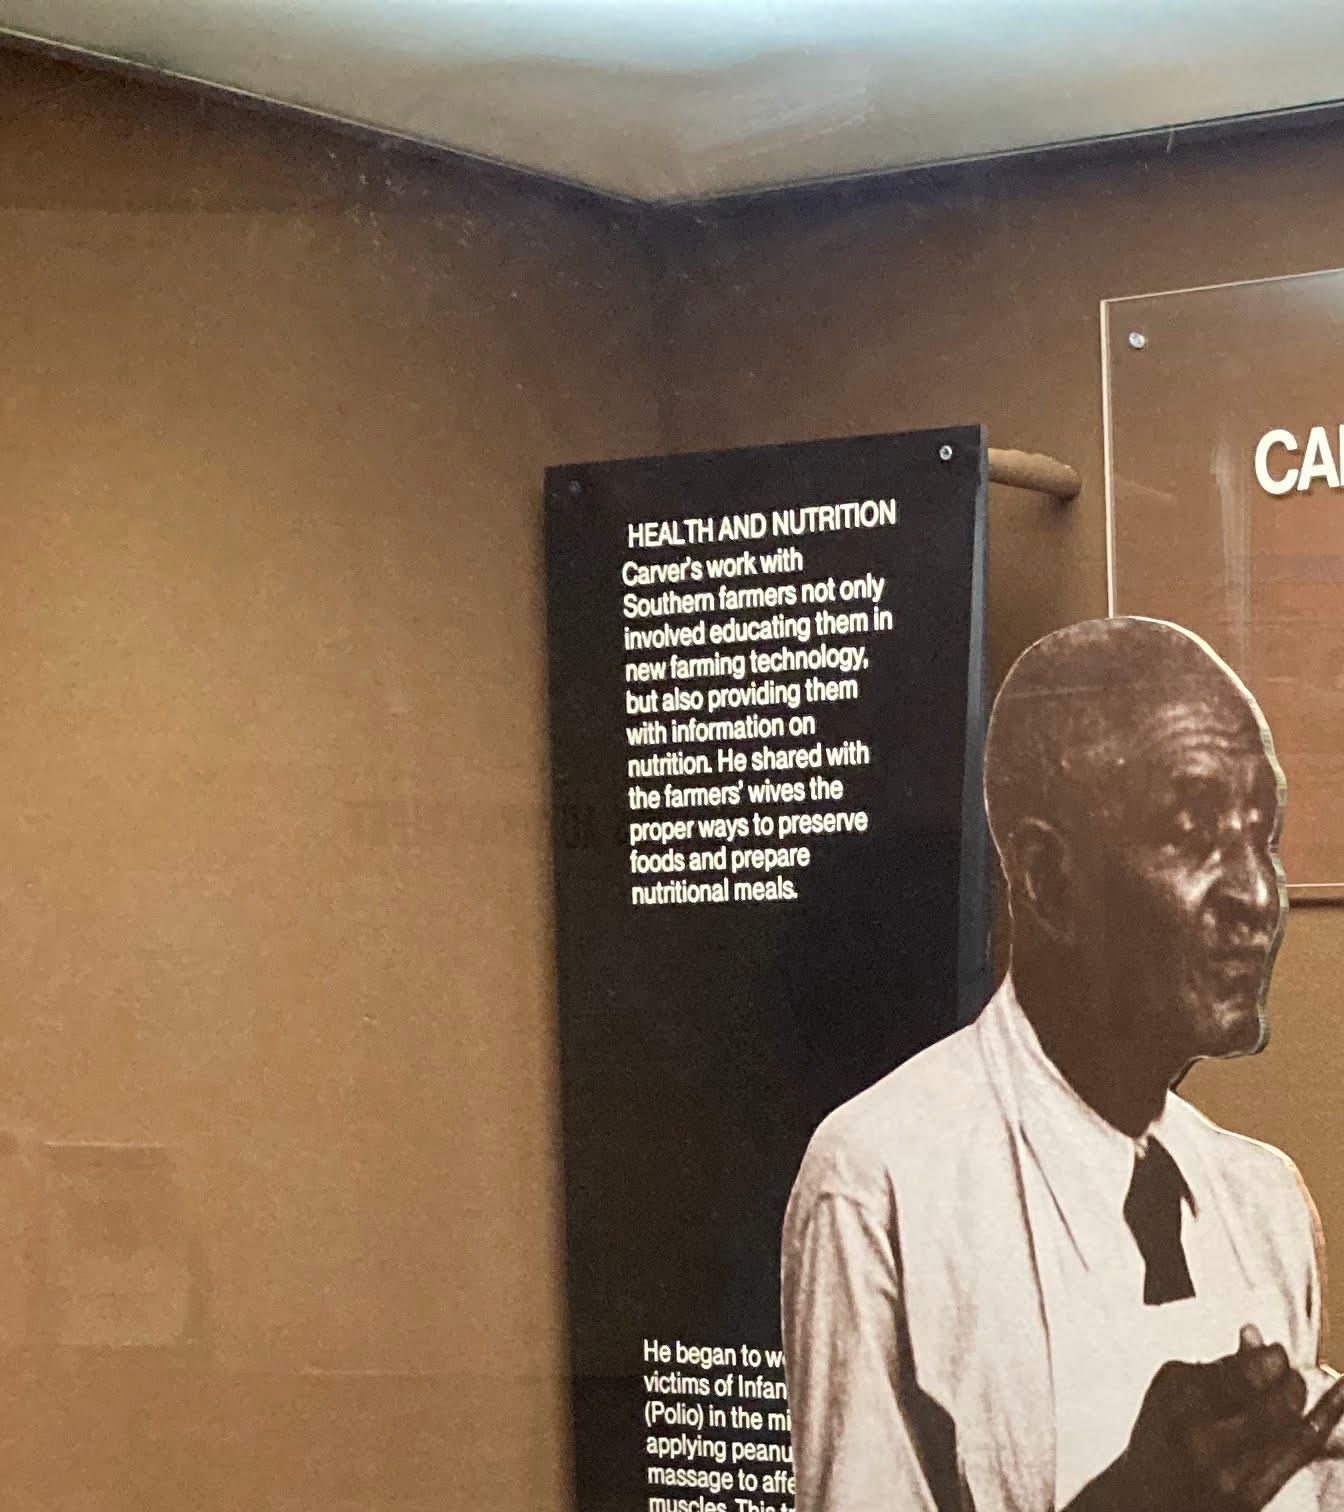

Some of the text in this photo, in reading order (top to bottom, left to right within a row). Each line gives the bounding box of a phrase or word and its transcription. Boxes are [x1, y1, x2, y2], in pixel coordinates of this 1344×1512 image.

[629, 500, 896, 548] HEALTH AND NUTRITION
[622, 547, 803, 586] Carver's work with
[623, 573, 885, 618] Southern farmers not only
[628, 740, 869, 777] nutrition. He shared with
[628, 775, 843, 809] the farmers' wives the
[632, 875, 798, 904] nutritional meals.
[644, 1339, 761, 1369] He began to
[644, 1372, 710, 1395] victims
[714, 1374, 733, 1396] of
[645, 1401, 763, 1430] (Polio) in the
[647, 1434, 726, 1463] applying
